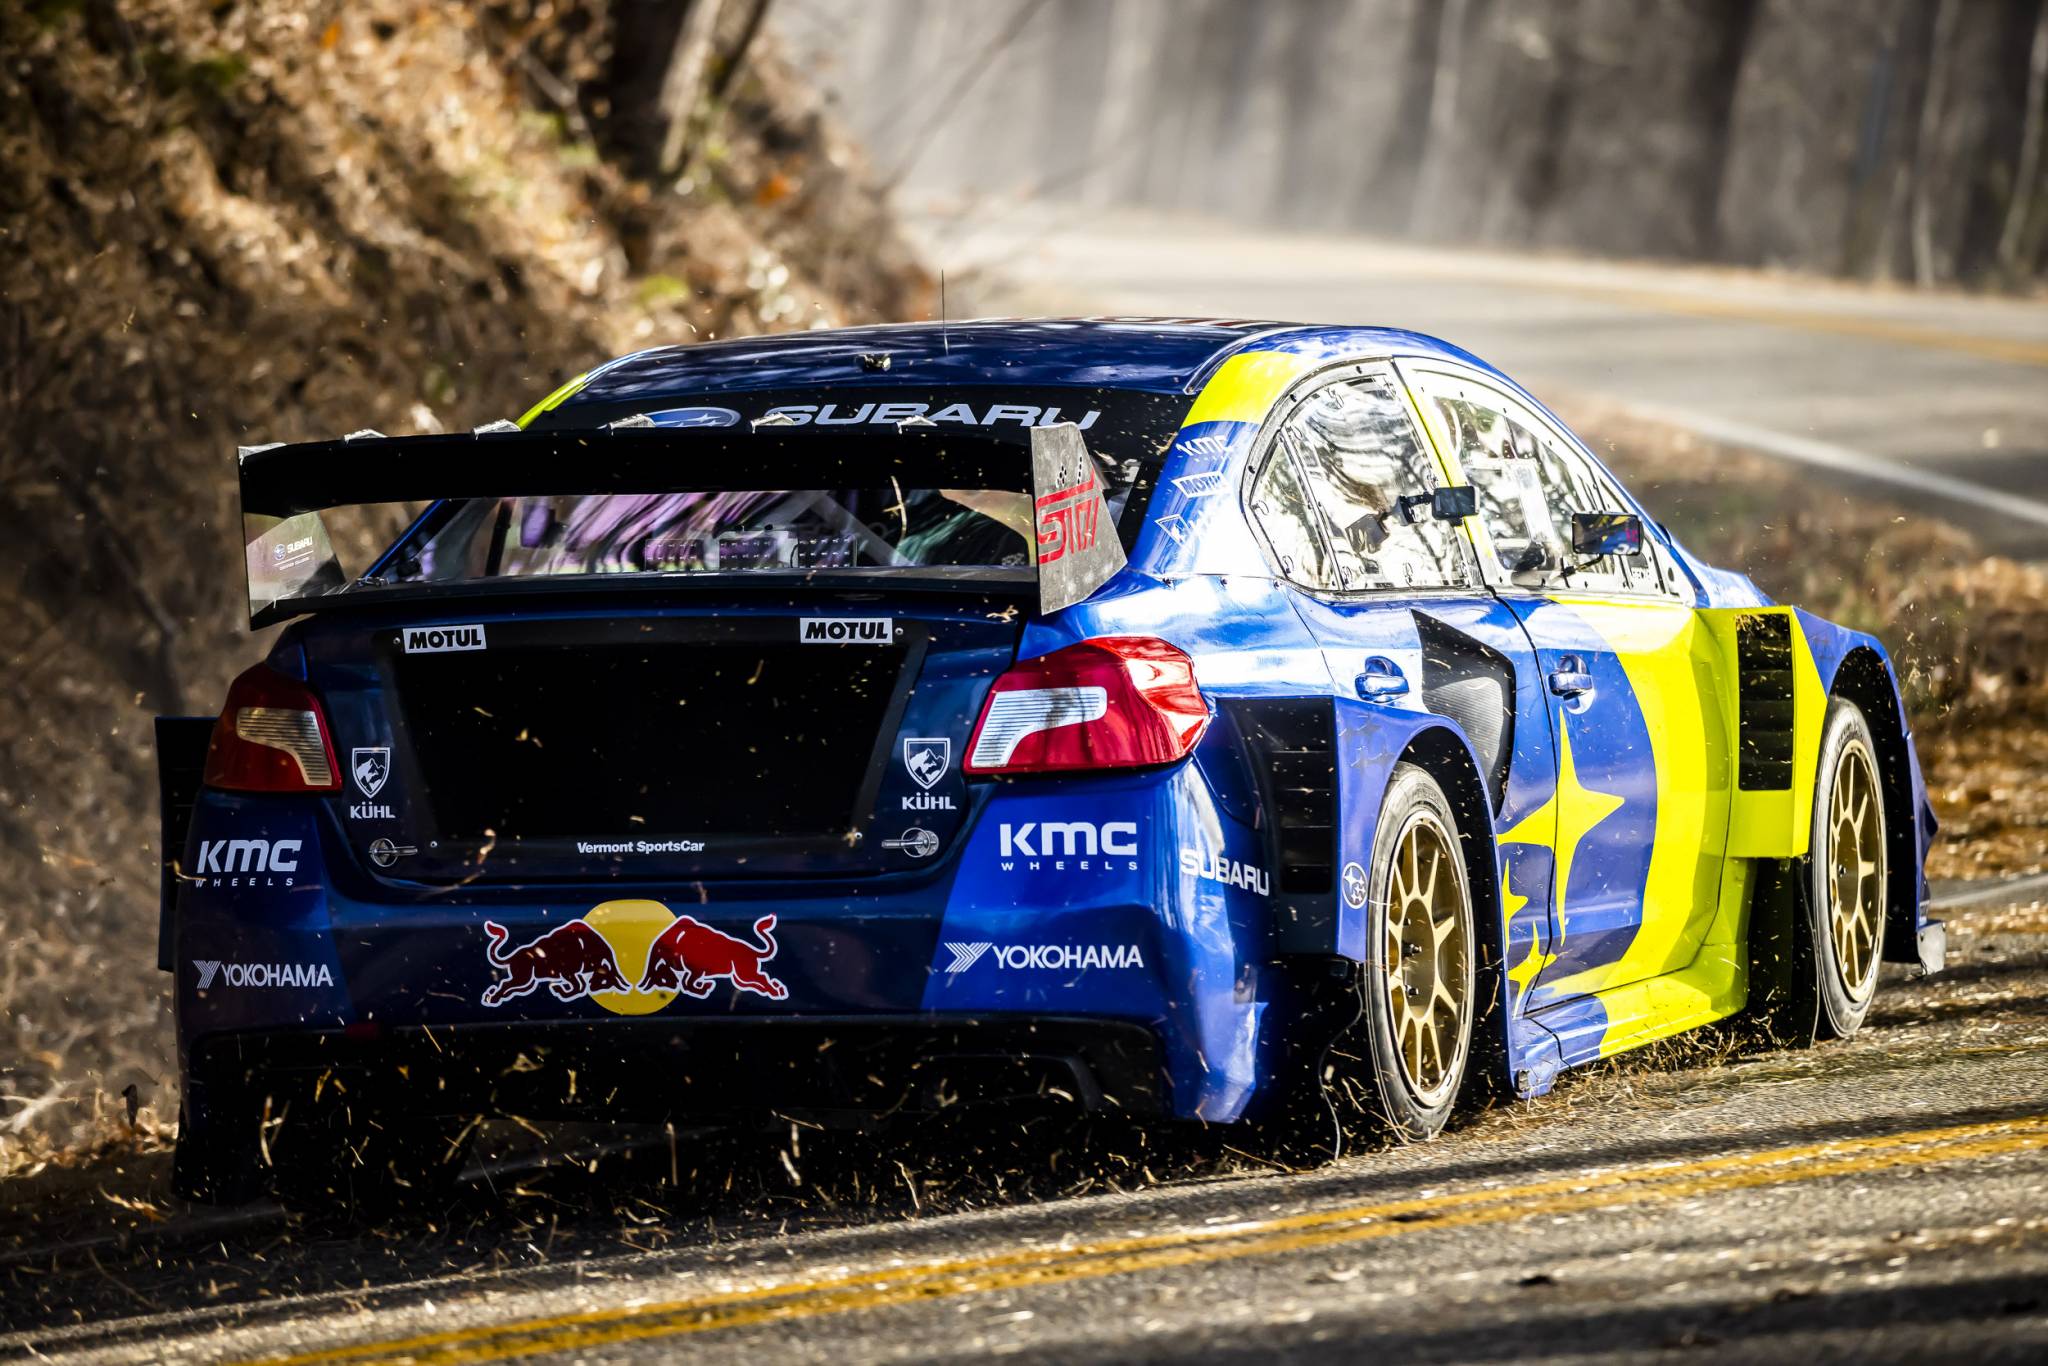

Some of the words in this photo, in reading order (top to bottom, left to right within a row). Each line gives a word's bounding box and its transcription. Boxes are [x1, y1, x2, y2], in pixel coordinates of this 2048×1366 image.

[763, 403, 1100, 430] SUBARU
[1179, 474, 1223, 496] MOTU
[1036, 467, 1099, 565] STI
[408, 630, 482, 650] MOTUL
[804, 621, 888, 641] MOTUL
[350, 801, 396, 819] KÜHL
[902, 793, 957, 810] KÜHL
[577, 841, 634, 853] Vermont
[636, 840, 705, 854] SportsCar
[1000, 822, 1137, 857] KMC
[196, 839, 302, 874] KMC
[1001, 861, 1138, 871] WHEELS
[196, 877, 294, 888] WHEELS
[1180, 849, 1270, 897] SUBARU
[992, 945, 1144, 969] YOKOHAMA
[221, 963, 334, 987] YOKOHAMA
